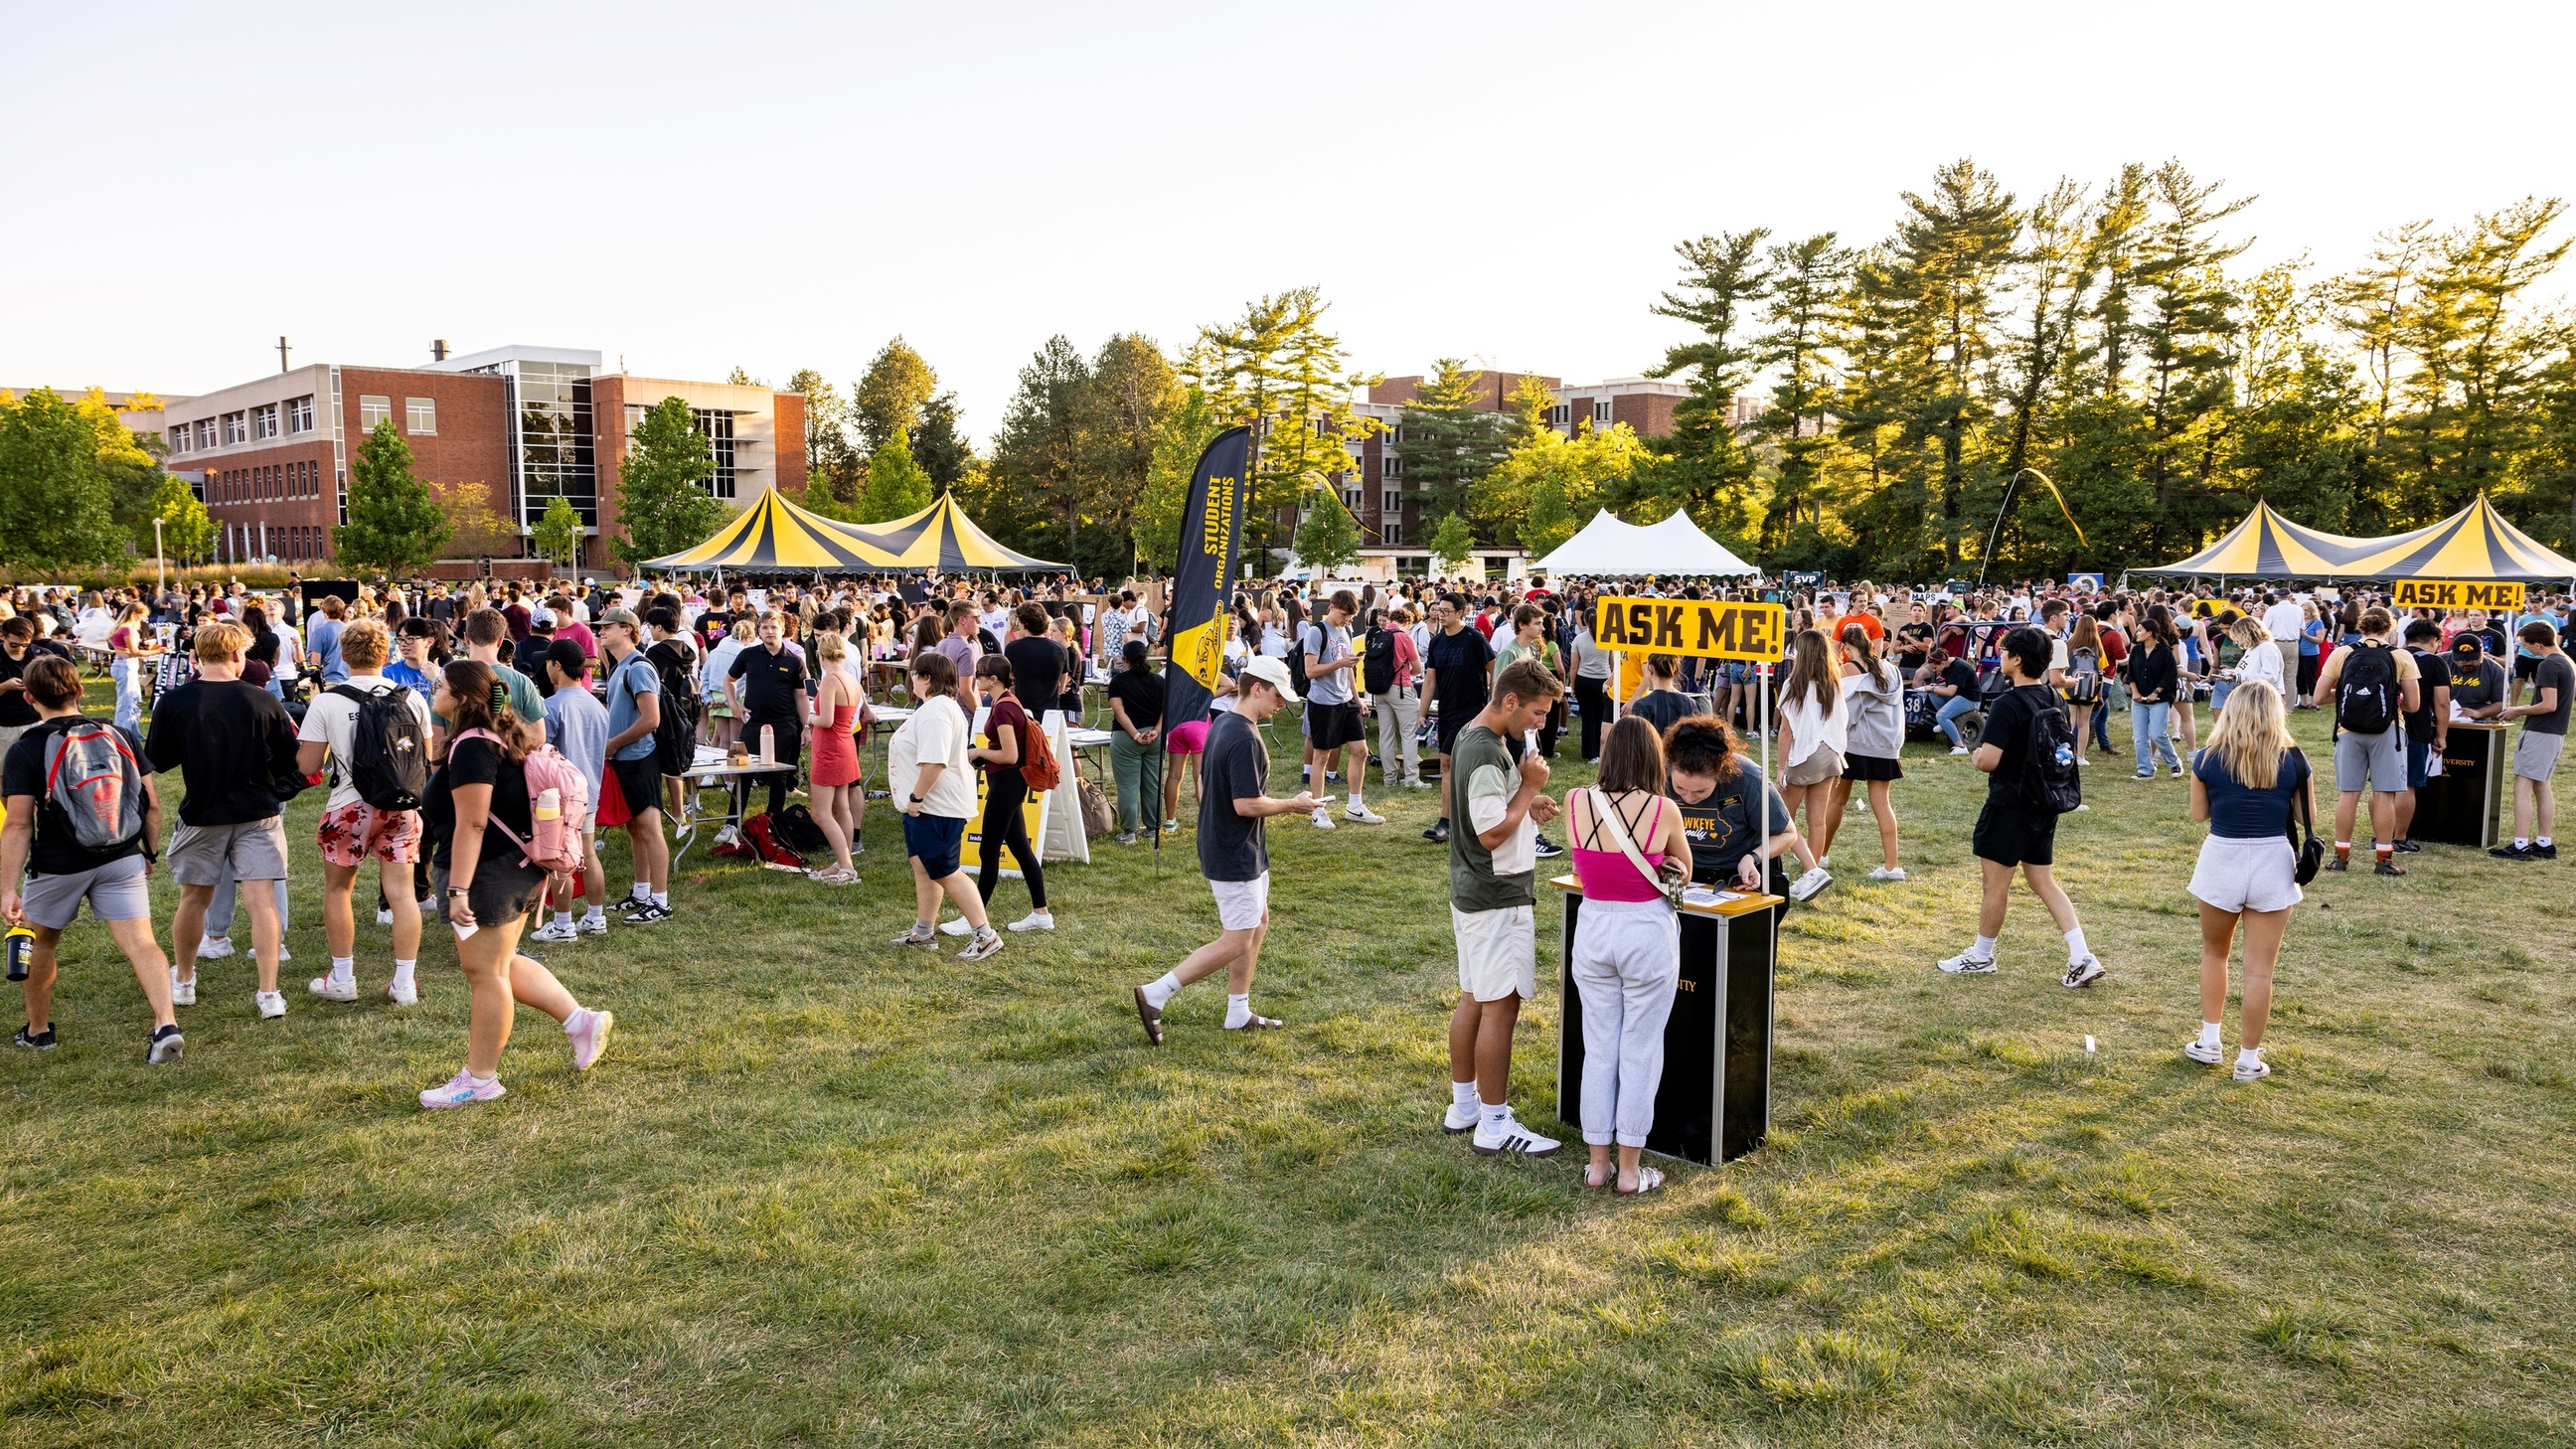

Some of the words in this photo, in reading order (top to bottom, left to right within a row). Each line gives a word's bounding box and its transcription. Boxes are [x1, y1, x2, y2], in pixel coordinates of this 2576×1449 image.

[1204, 474, 1221, 556] STUDENT
[1213, 476, 1235, 590] ORGANIZATIONS
[1794, 575, 1817, 584] SVP
[2398, 583, 2457, 605] ASK
[2465, 584, 2520, 607] ME!
[1600, 602, 1684, 648] ASK
[1696, 606, 1779, 655] ME!
[1905, 697, 1920, 714] 38
[1684, 816, 1715, 831] WKEYE
[1685, 827, 1707, 841] mily
